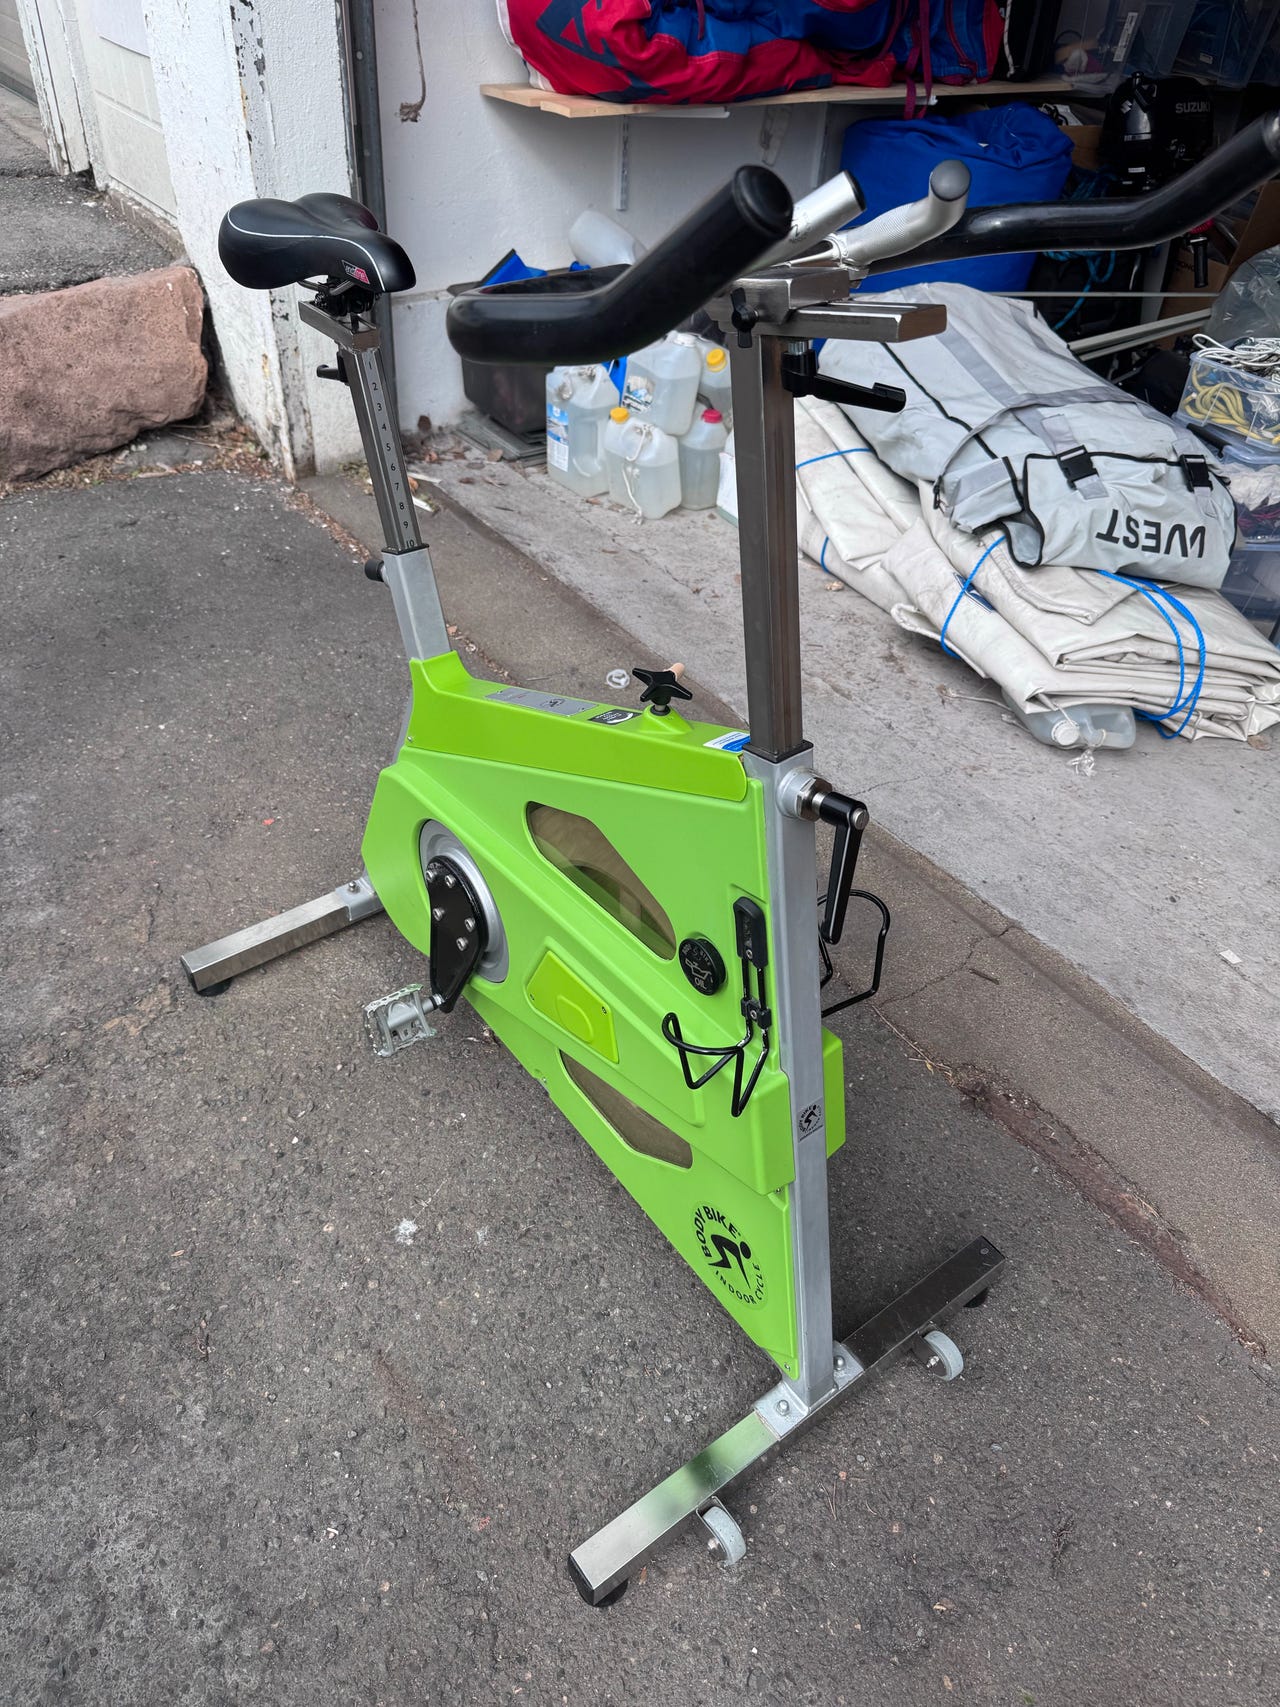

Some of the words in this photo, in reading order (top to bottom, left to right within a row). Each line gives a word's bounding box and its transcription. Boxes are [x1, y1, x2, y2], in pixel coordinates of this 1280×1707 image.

[1175, 101, 1211, 114] SUZUKI
[372, 382, 378, 391] 2
[376, 403, 382, 412] 3
[381, 423, 387, 431] 4
[386, 443, 391, 451] 5
[390, 463, 396, 471] 6
[395, 483, 400, 491] 7
[399, 502, 405, 510] 8
[403, 521, 409, 529] 9
[1095, 508, 1206, 559] WEST
[406, 539, 414, 547] 10
[694, 977, 707, 990] OIL
[694, 1207, 712, 1257] BODY
[703, 1205, 737, 1239] BIKE
[715, 1270, 757, 1304] INDOOR
[752, 1262, 764, 1300] CYCLE
